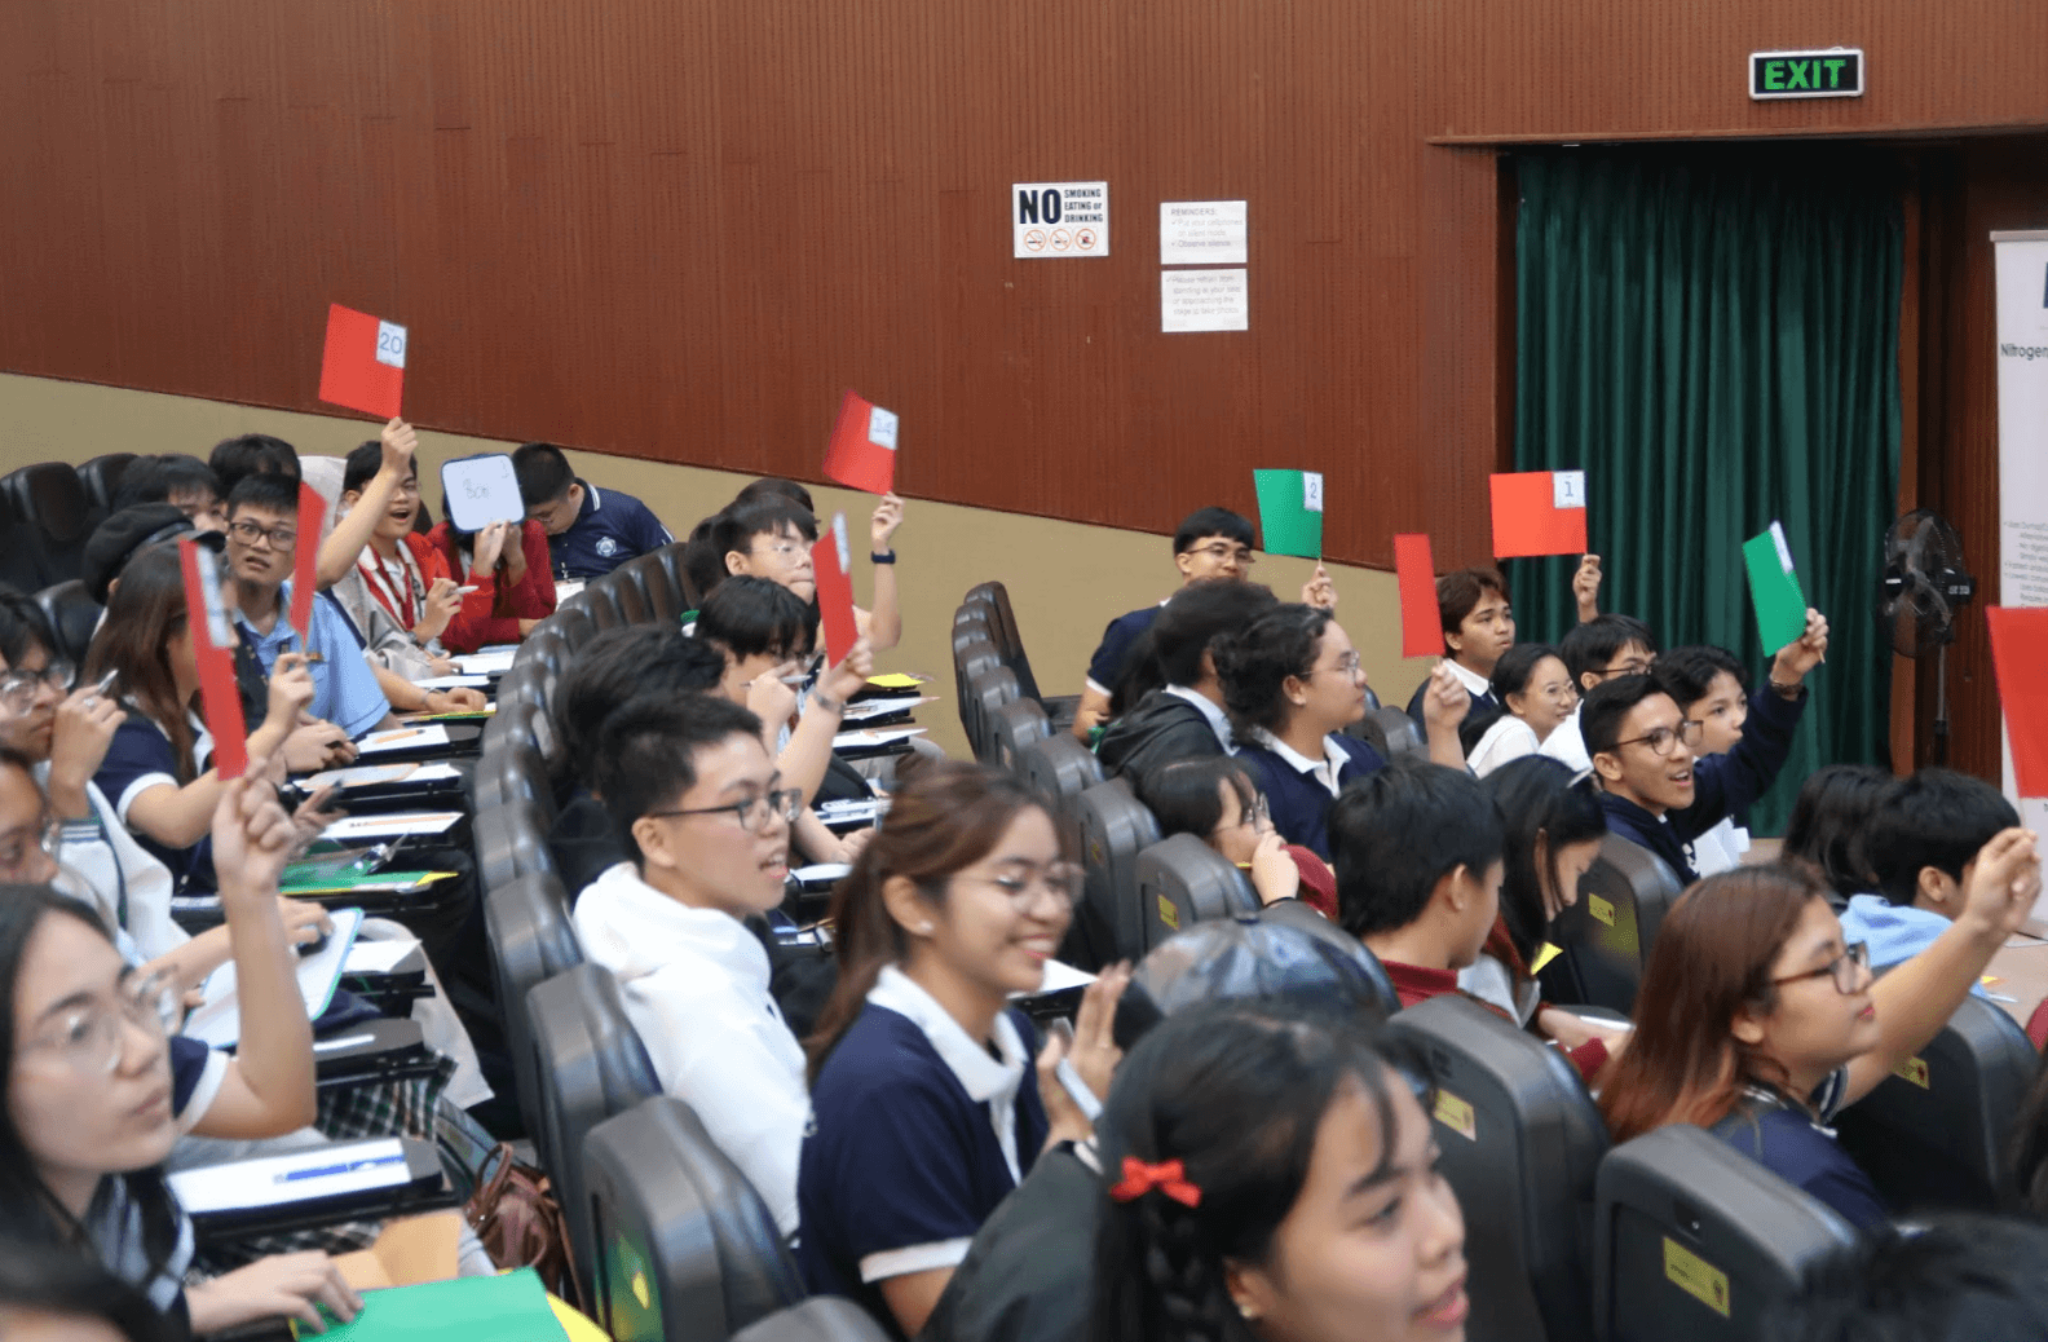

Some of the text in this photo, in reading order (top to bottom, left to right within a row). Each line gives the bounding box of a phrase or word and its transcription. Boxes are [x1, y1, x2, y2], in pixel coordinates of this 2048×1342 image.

[1765, 59, 1846, 90] EXIT
[1064, 188, 1101, 198] SMOKING
[1019, 188, 1062, 225] NO
[1064, 201, 1103, 211] EATING or
[1064, 213, 1104, 223] DRINKING
[380, 331, 403, 354] 20
[1310, 482, 1317, 499] 2
[1564, 481, 1574, 497] 1
